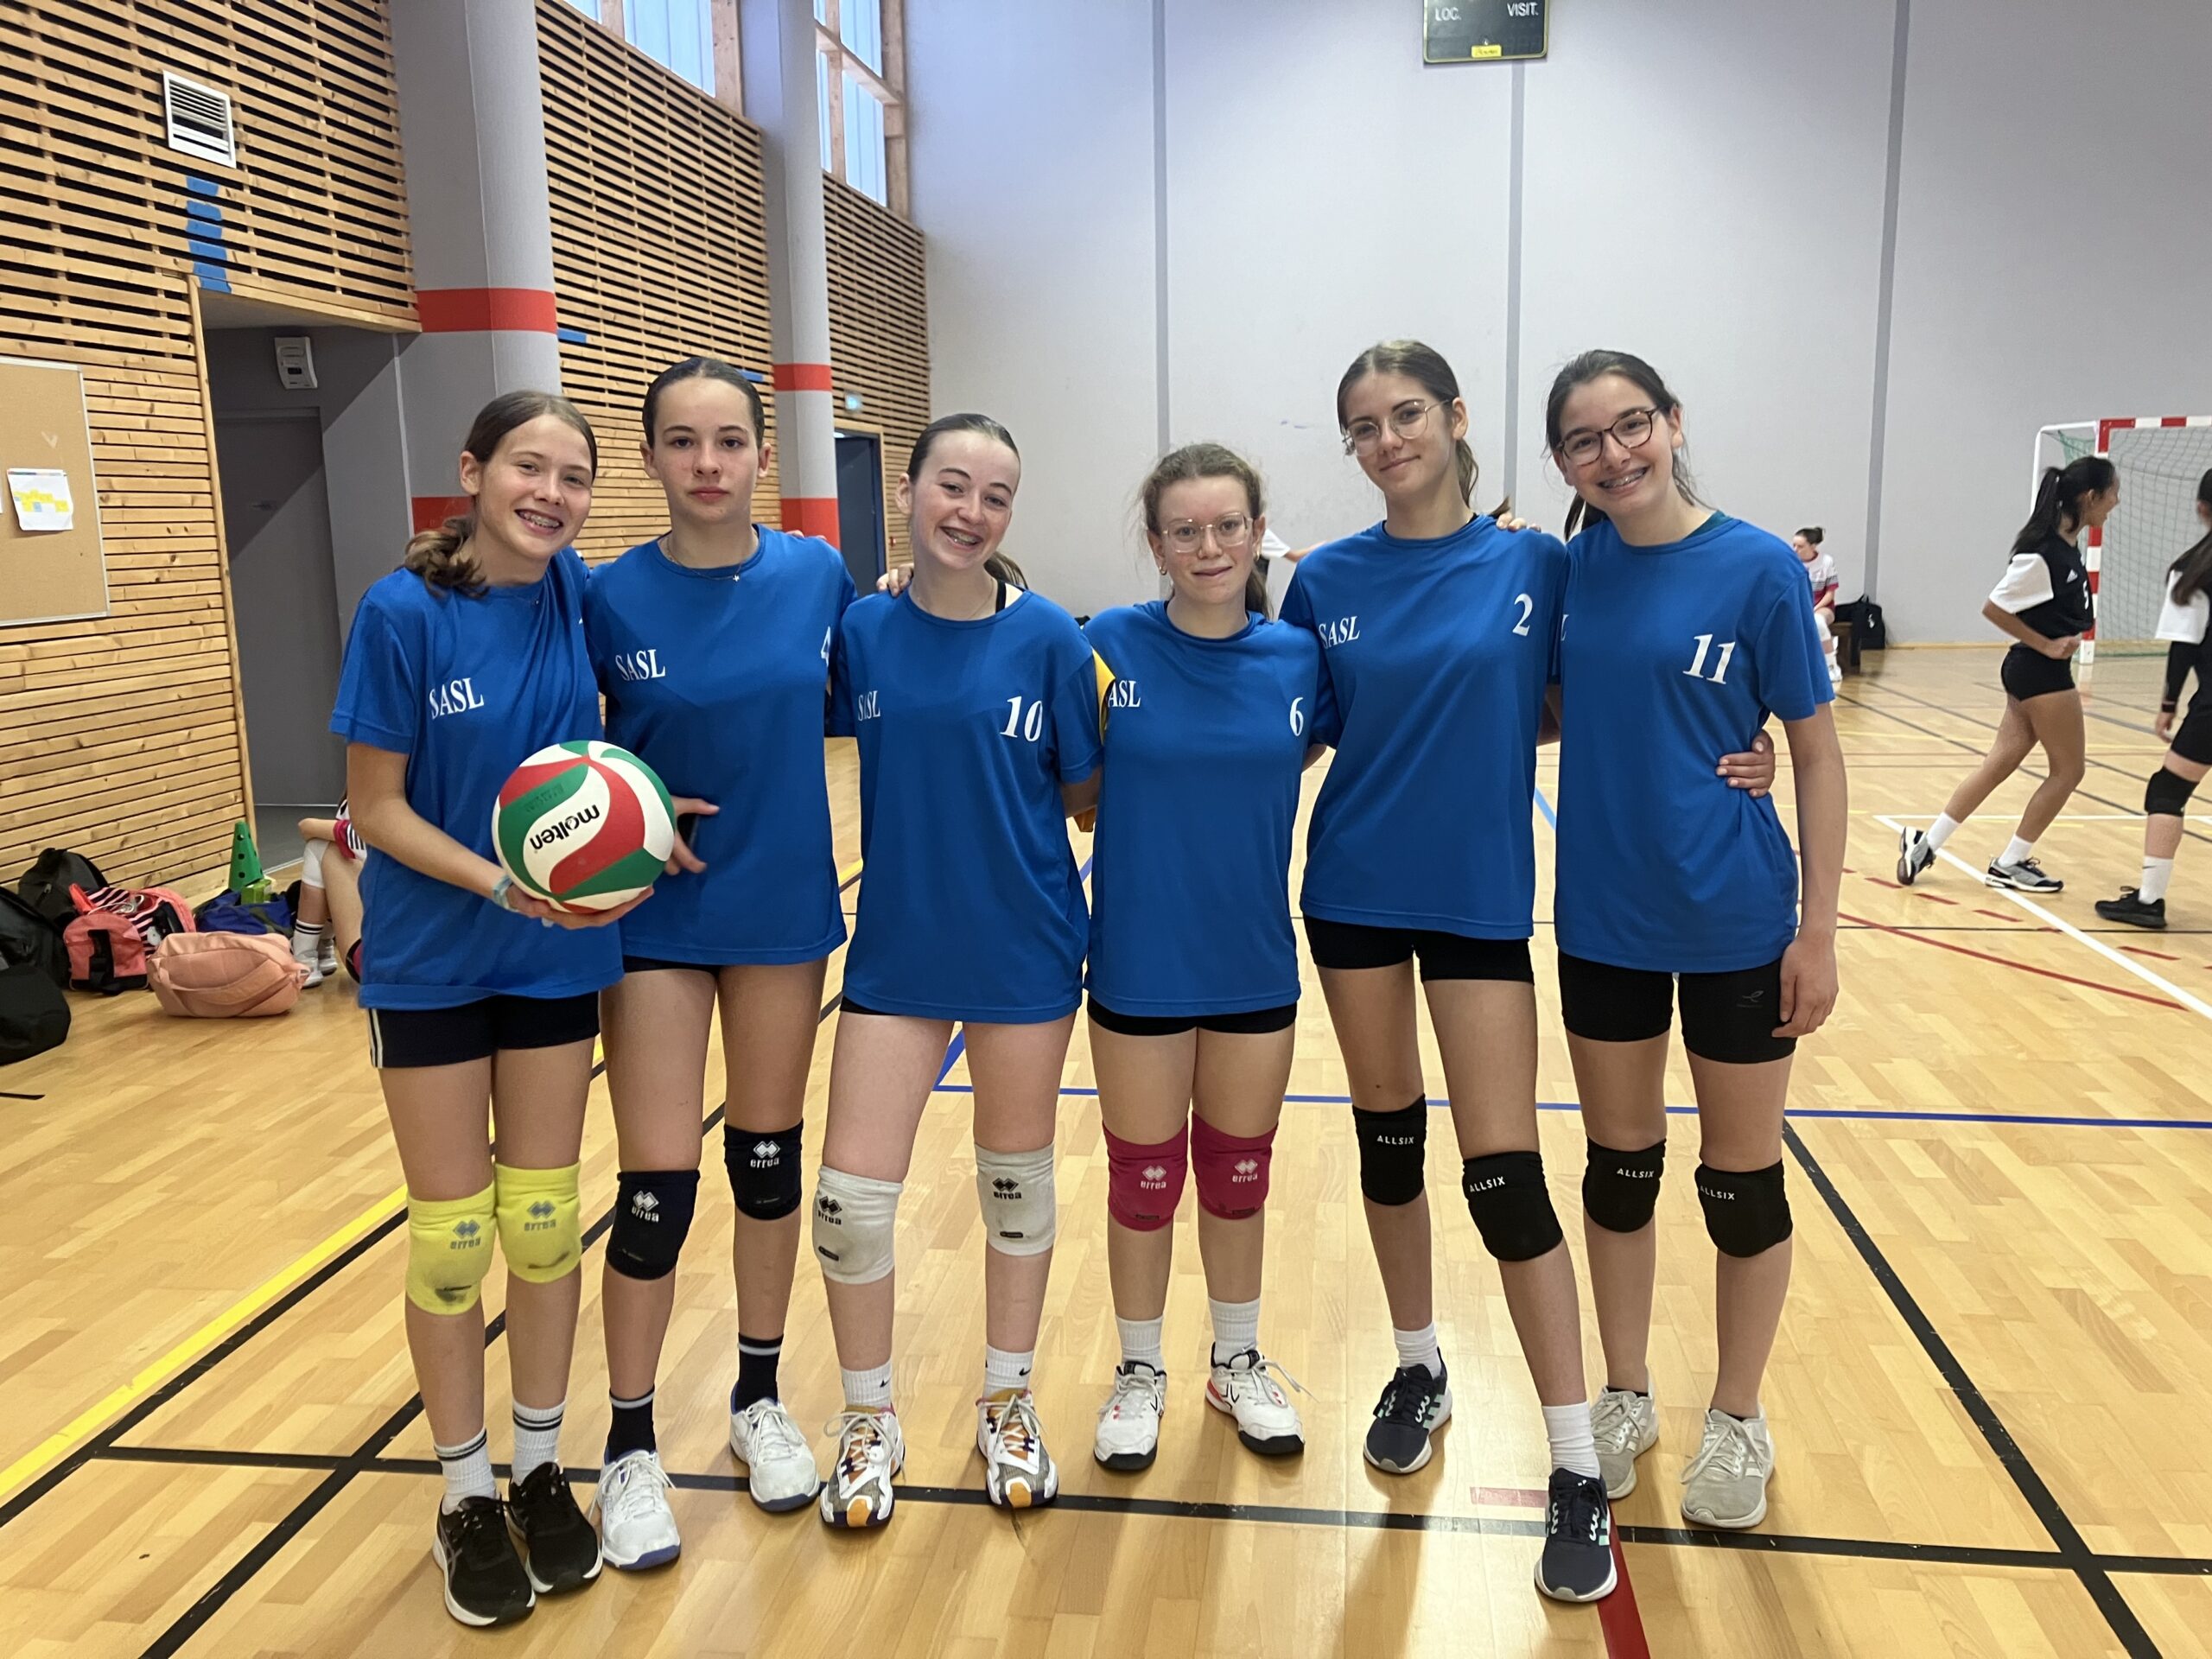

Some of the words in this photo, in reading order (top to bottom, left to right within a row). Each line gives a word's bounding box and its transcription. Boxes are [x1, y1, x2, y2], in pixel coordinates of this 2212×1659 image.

[1507, 2, 1539, 16] VISIT.
[1512, 593, 1533, 637] 2
[1319, 615, 1361, 649] SASL
[614, 649, 666, 682] SASL
[1682, 633, 1736, 685] 11
[429, 677, 484, 720] SASL
[858, 690, 880, 721] SASL
[1107, 679, 1141, 708] ASL
[999, 696, 1043, 742] 10
[1289, 696, 1304, 736] 6
[530, 804, 601, 850] molten
[1376, 1135, 1415, 1145] ALLSIX
[1469, 1175, 1506, 1192] ALLSIX
[1616, 1166, 1655, 1179] ALLSIX
[1700, 1185, 1735, 1201] ALLSIX
